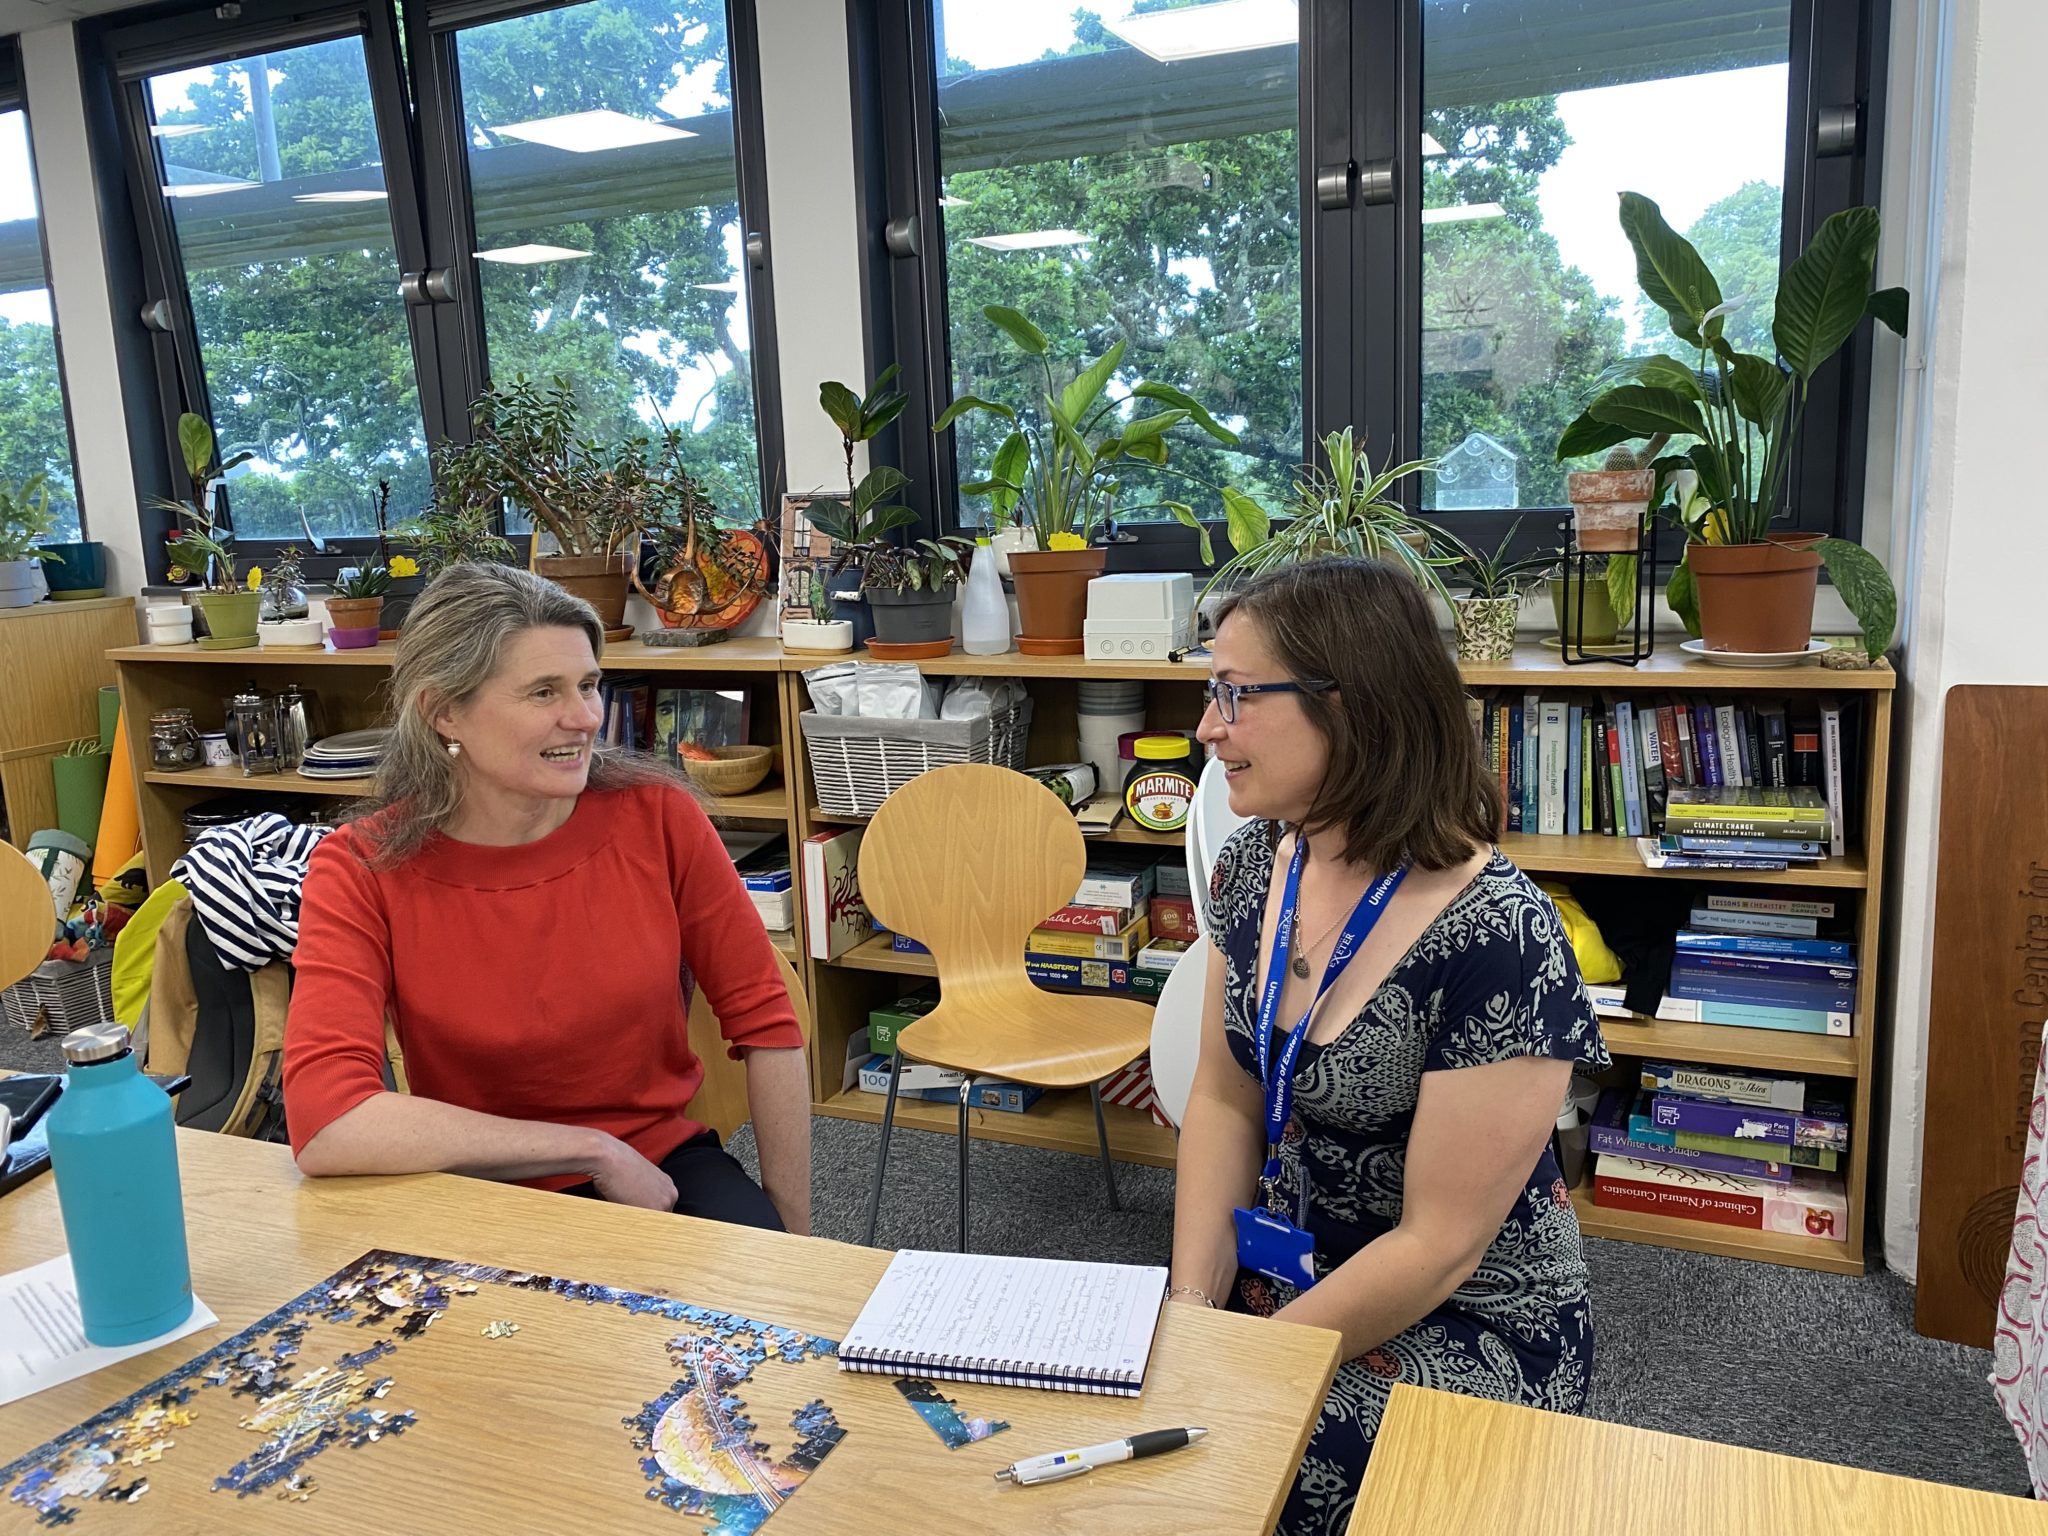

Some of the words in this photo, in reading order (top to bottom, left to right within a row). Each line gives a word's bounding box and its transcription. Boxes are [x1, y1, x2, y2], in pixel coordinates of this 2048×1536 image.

[1720, 710, 1734, 752] Ecological
[1649, 731, 1659, 762] WATER
[1726, 753, 1736, 780] Health
[1136, 777, 1191, 798] MARMITE
[2018, 860, 2048, 900] for
[1750, 902, 1787, 910] CHEMISTRY
[1046, 914, 1070, 925] atha
[1278, 908, 1294, 948] EXETER
[1329, 932, 1355, 968] EXETER
[1040, 963, 1080, 972] HAASTEREN
[2011, 914, 2048, 1008] Centre
[1260, 981, 1278, 1030] University
[1259, 1034, 1266, 1046] of
[1282, 1034, 1298, 1065] Exeter
[862, 1073, 889, 1087] 100
[1280, 1065, 1286, 1076] of
[1676, 1074, 1731, 1090] DRAGONS
[1740, 1082, 1767, 1094] Skies
[1272, 1077, 1286, 1122] University
[1597, 1133, 1612, 1144] Fat
[1615, 1136, 1645, 1149] White
[1648, 1143, 1666, 1153] Cat
[1668, 1145, 1700, 1157] Studio
[1602, 1185, 1656, 1200] Curiosities
[1660, 1193, 1698, 1206] Natural
[1698, 1199, 1712, 1209] of
[1713, 1200, 1756, 1215] Cabinet
